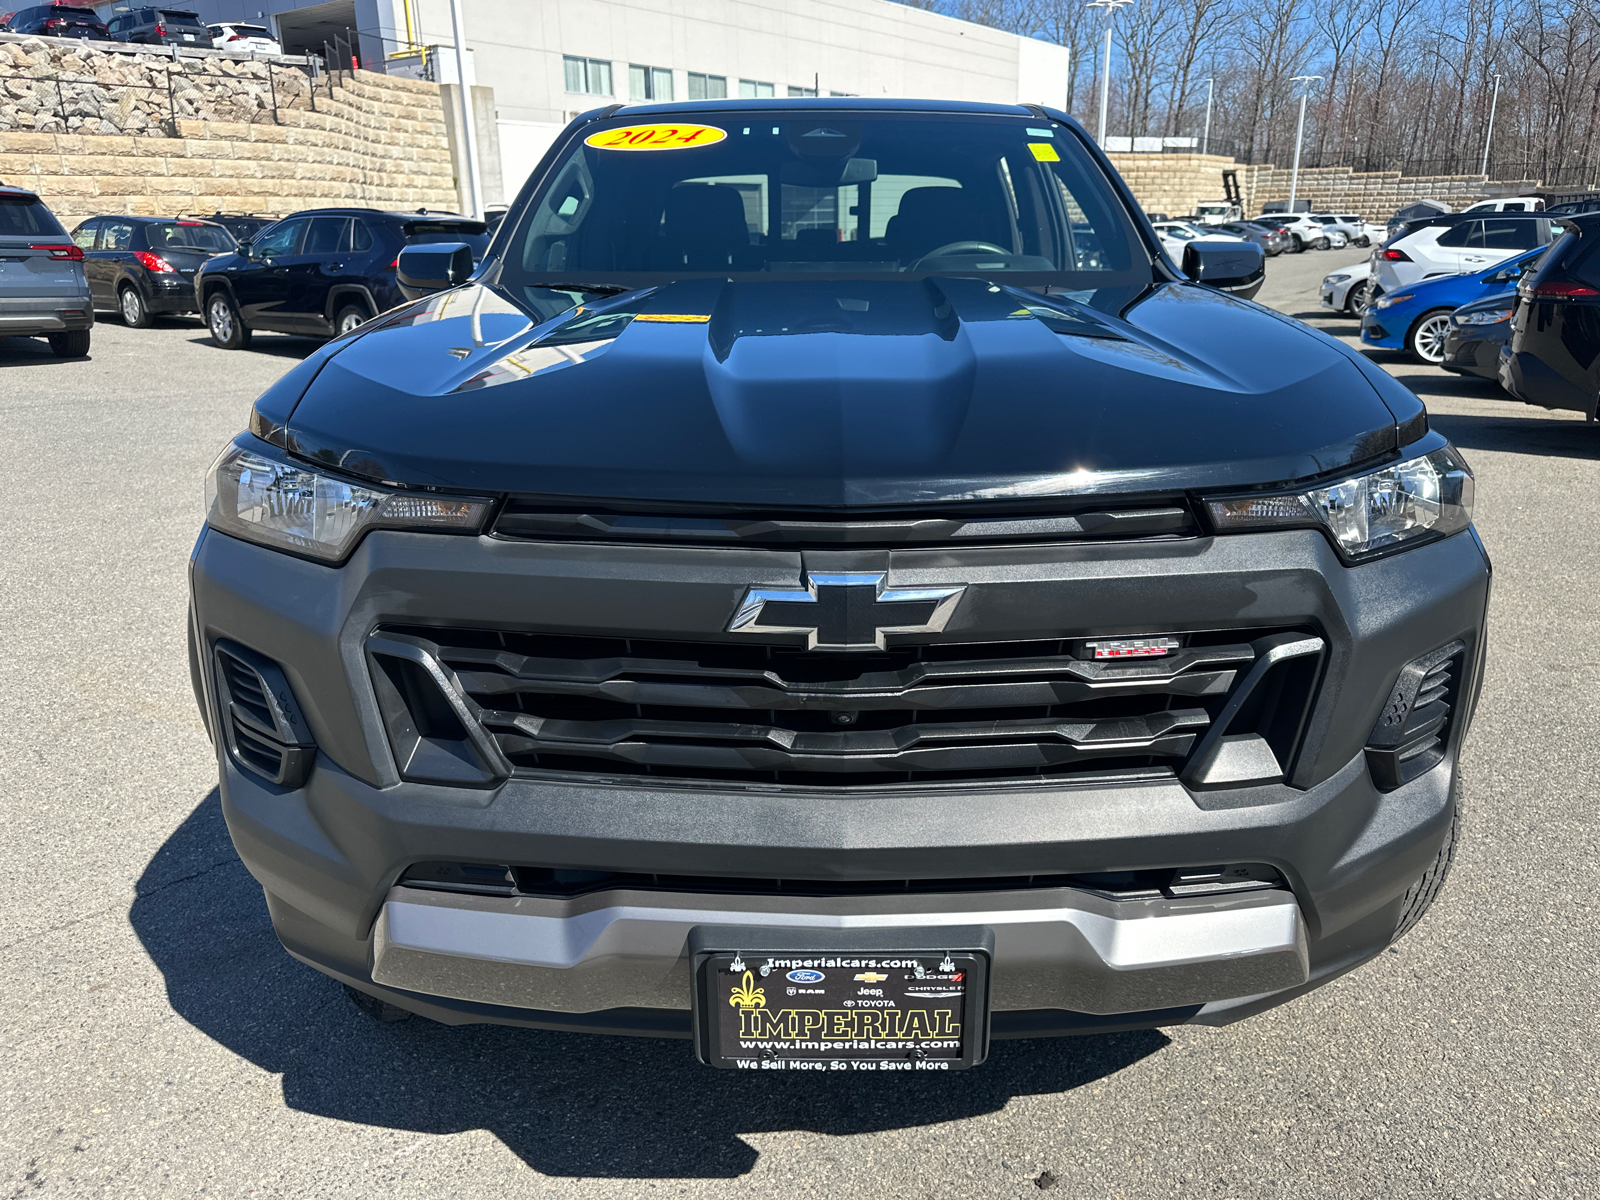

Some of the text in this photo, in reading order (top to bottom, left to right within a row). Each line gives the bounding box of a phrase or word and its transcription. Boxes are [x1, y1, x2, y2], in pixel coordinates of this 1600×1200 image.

[602, 128, 707, 146] 2024
[767, 957, 917, 969] Imperialcars.com
[857, 987, 883, 997] Jeep
[739, 1008, 960, 1039] IMPERIAL
[740, 1040, 960, 1051] www.imperialcars.com
[736, 1060, 949, 1072] We Sell More, So You Save More
